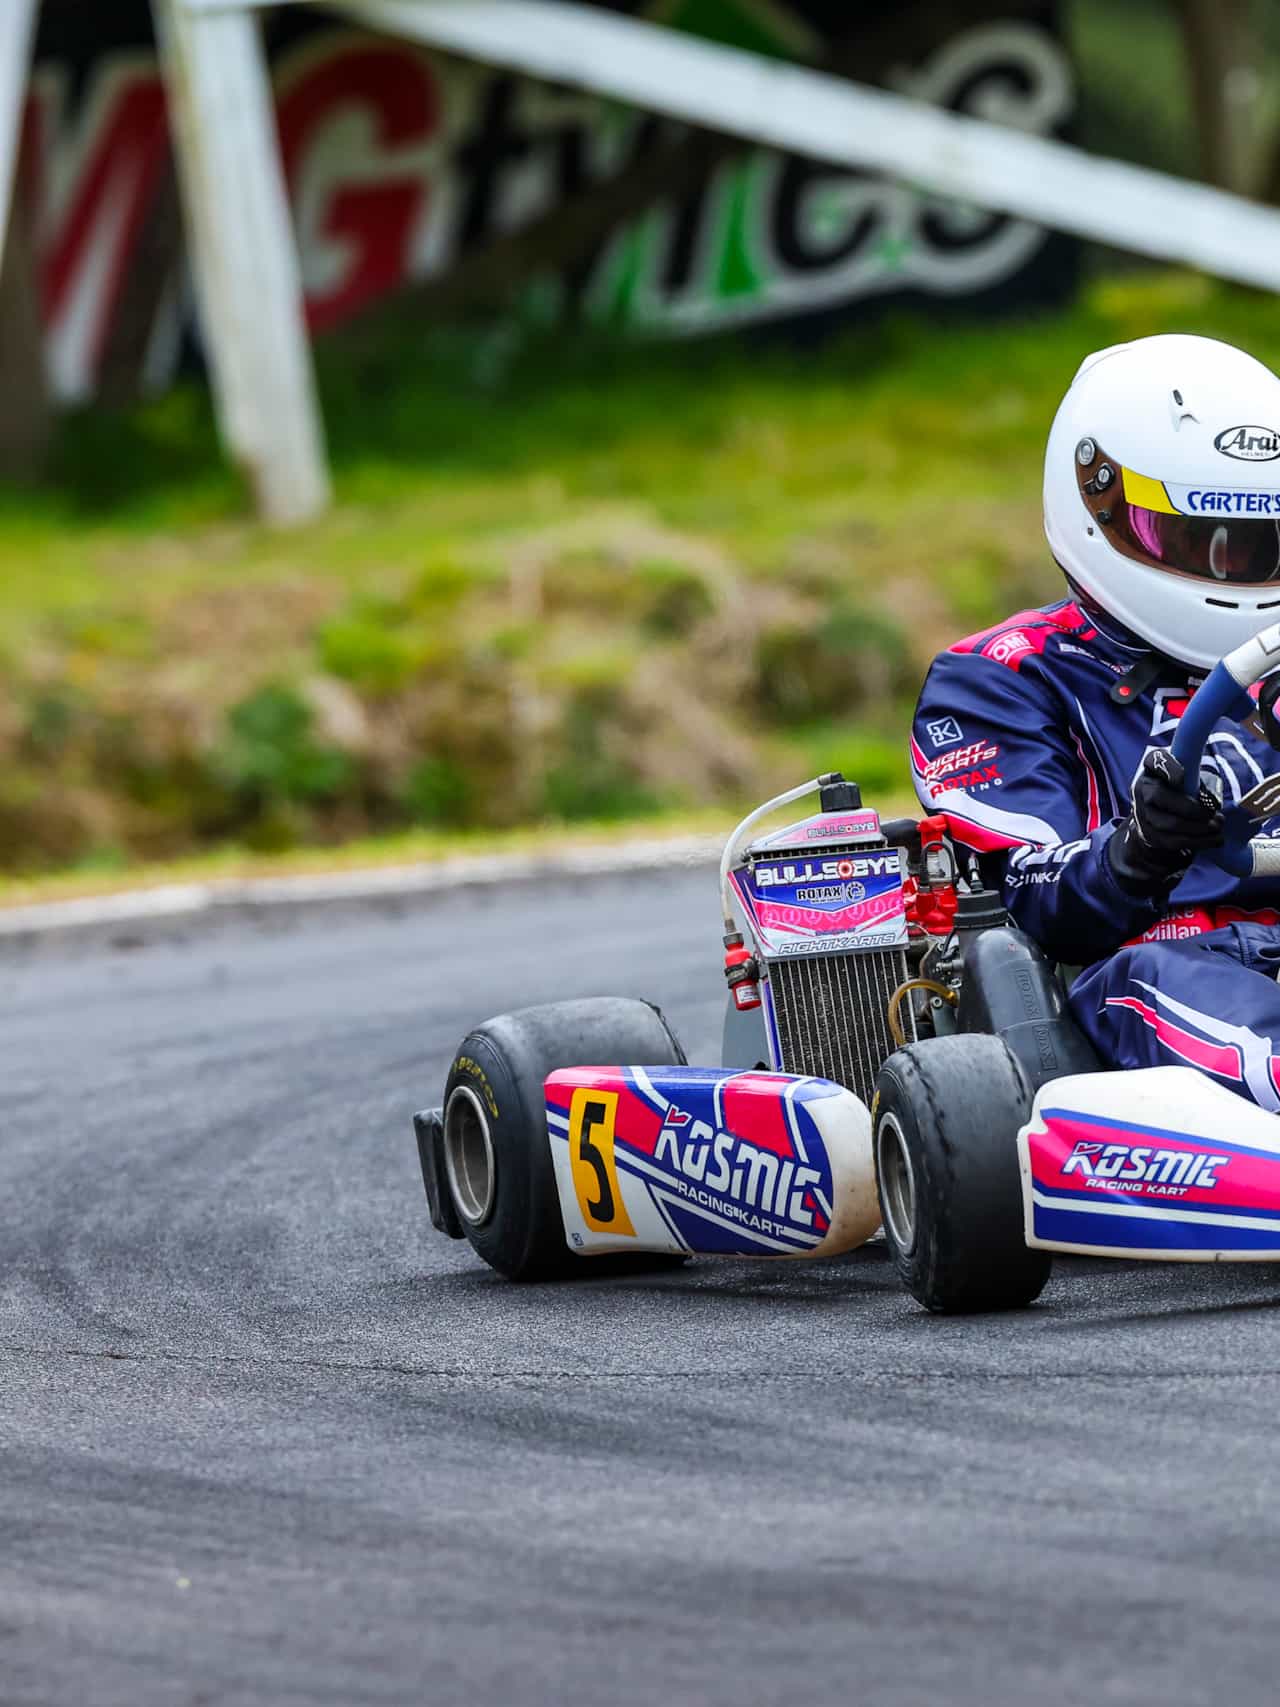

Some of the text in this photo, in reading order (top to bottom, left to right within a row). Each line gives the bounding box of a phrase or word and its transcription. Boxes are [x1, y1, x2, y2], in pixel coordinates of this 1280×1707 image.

[1221, 429, 1279, 451] Arai
[923, 740, 987, 777] RIGHT
[926, 746, 998, 786] KARTS
[930, 763, 1003, 799] ROTAX
[797, 886, 842, 900] ROTAX
[580, 1102, 615, 1222] 5
[653, 1105, 823, 1226] KOSMIC
[1062, 1141, 1231, 1188] KOSMIC
[1086, 1178, 1188, 1196] RACING KART
[677, 1180, 786, 1236] RACING KART
